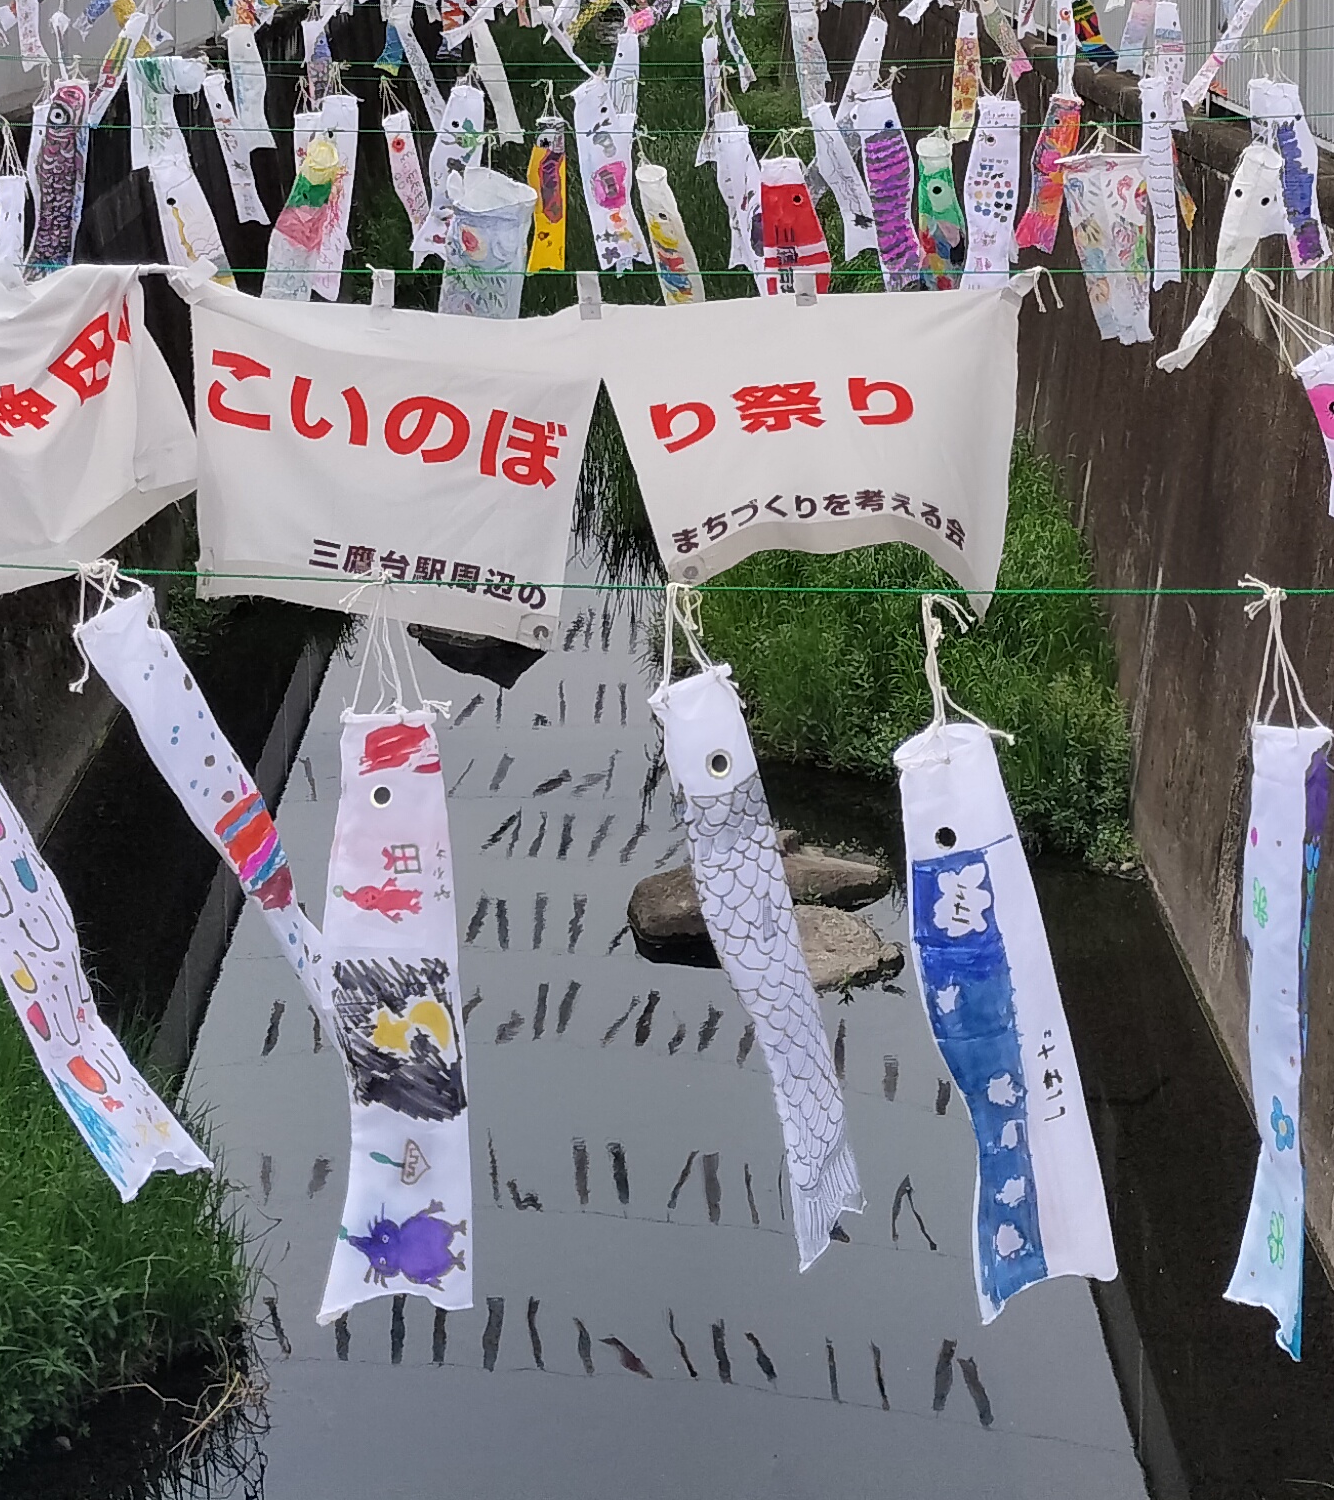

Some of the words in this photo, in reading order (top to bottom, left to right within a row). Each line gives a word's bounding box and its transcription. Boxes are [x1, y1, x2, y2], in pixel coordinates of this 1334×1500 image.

[207, 348, 568, 489] こいのぼ
[649, 377, 914, 453] り祭り
[671, 488, 966, 555] まちづくりを考える会
[308, 537, 547, 610] 三鷹台駅周辺の
